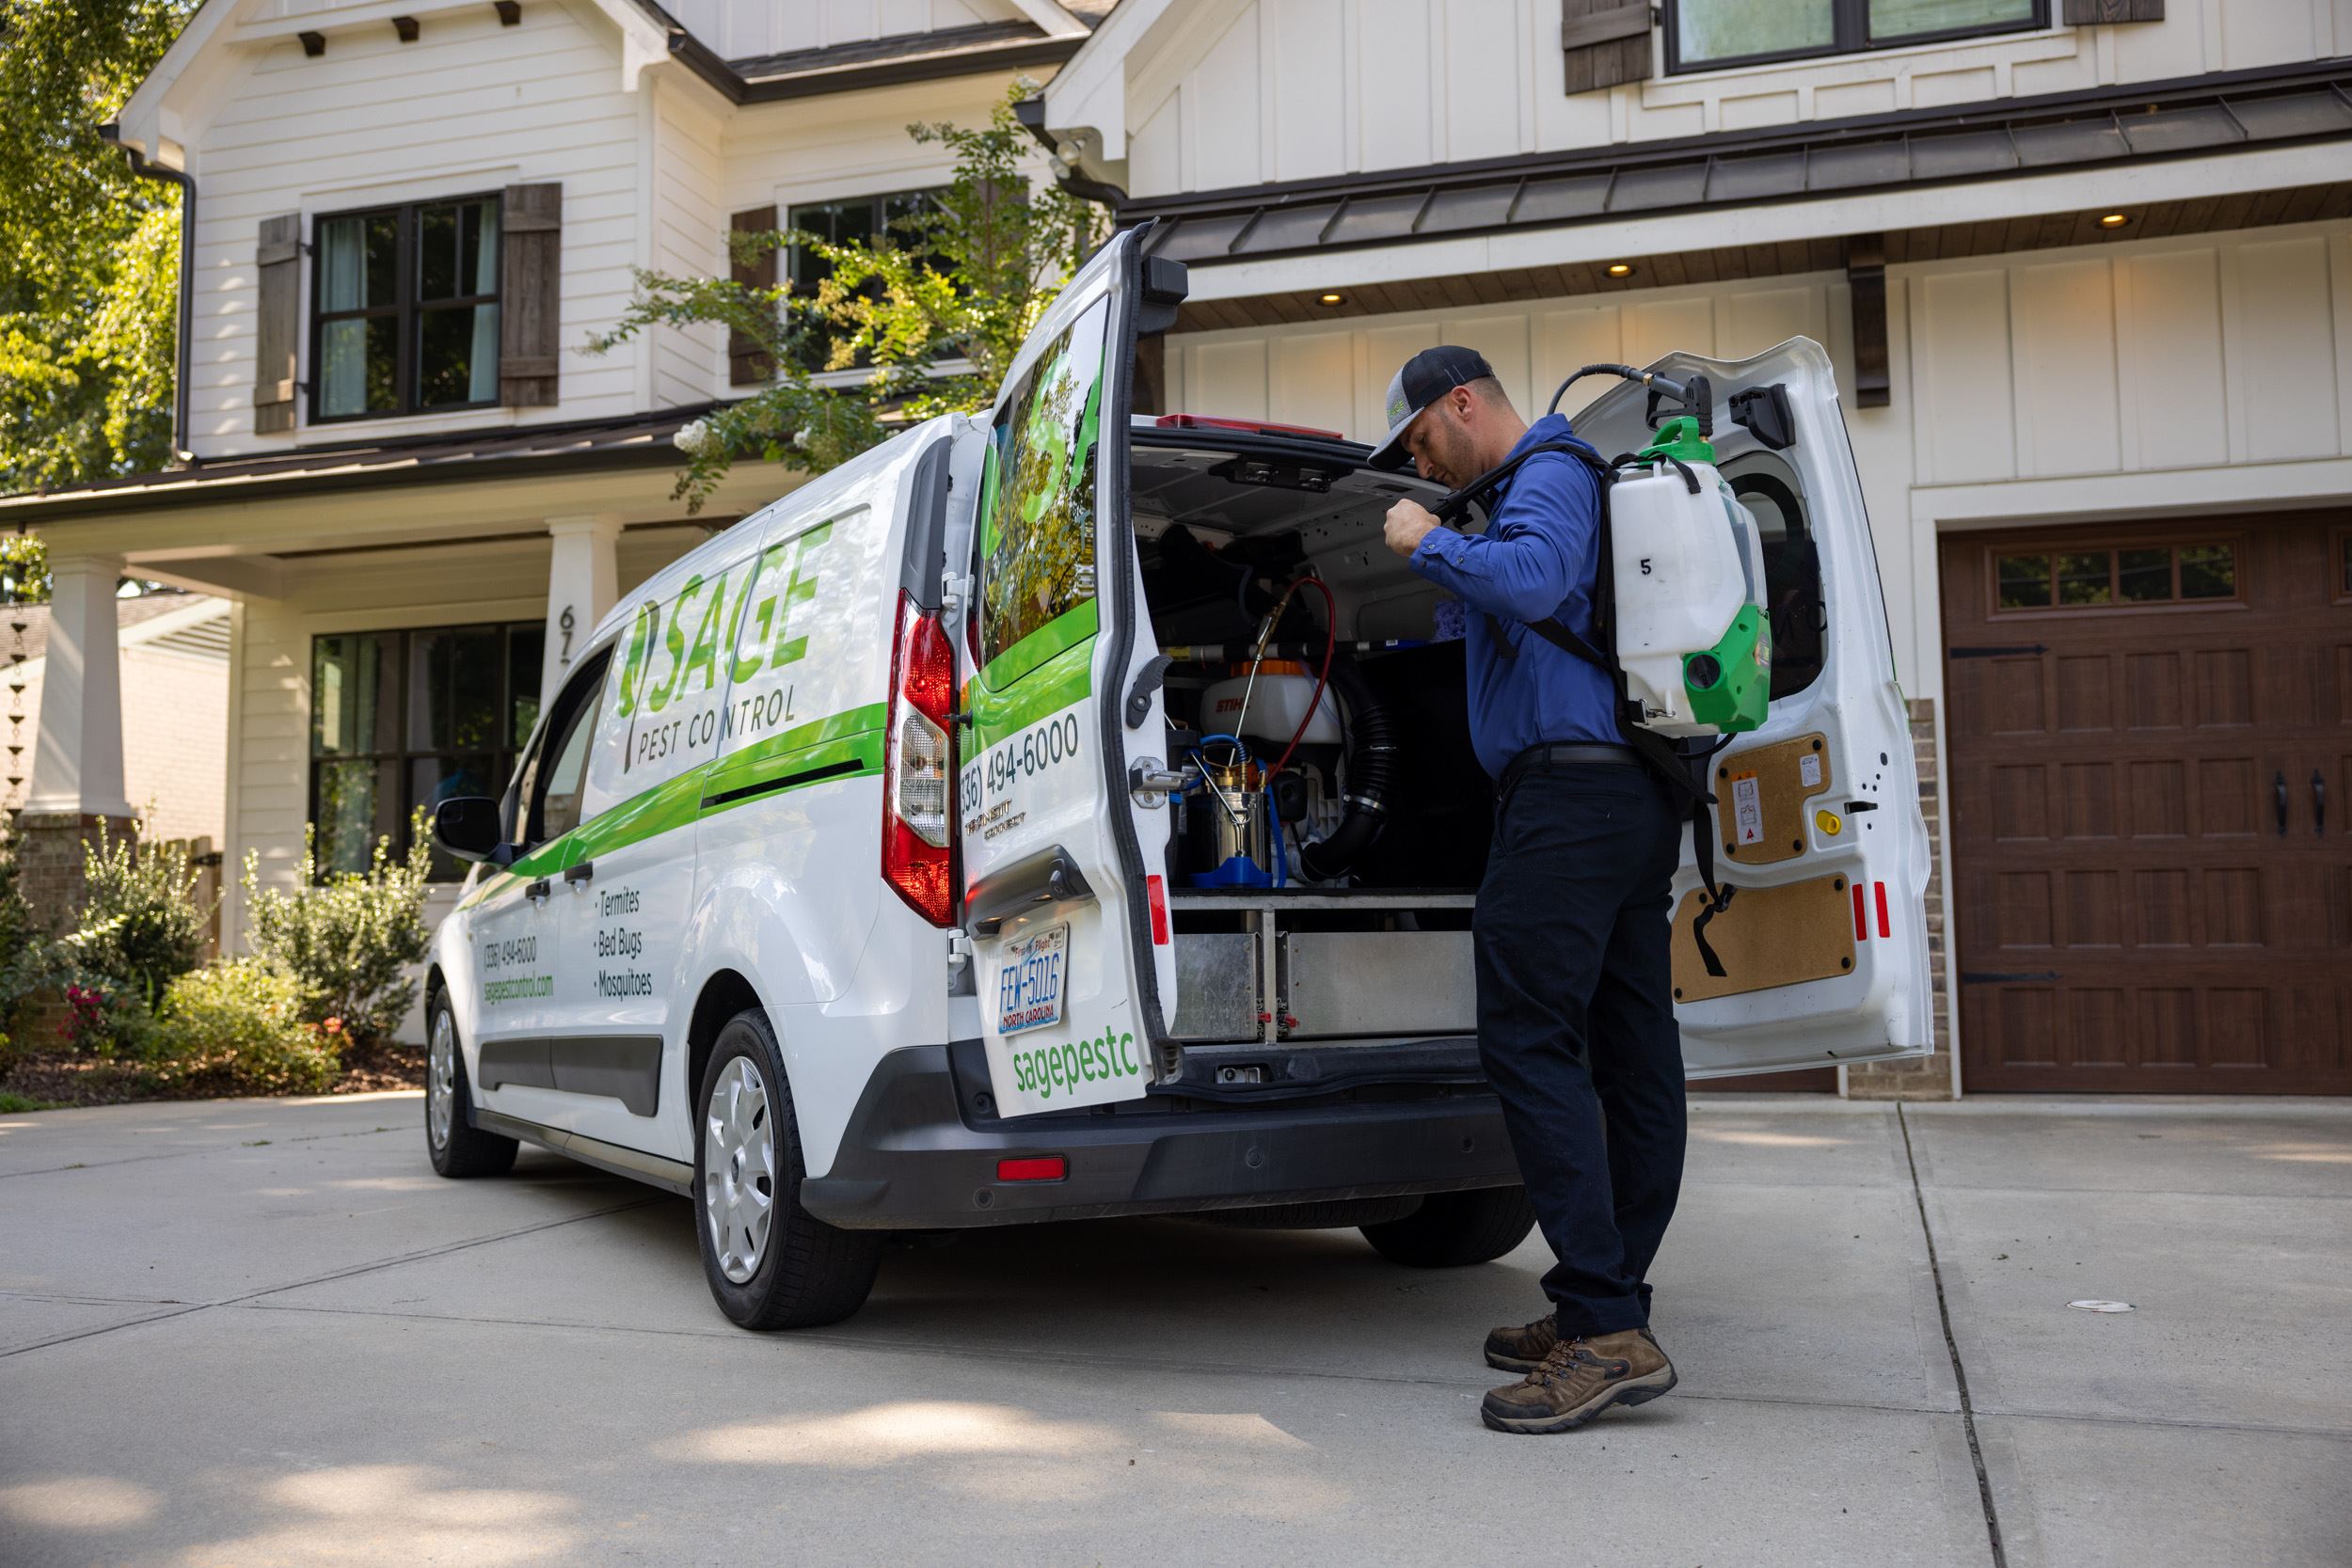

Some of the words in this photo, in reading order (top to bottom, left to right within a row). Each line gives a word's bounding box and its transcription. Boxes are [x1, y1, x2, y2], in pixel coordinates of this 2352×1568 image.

[1640, 558, 1652, 576] 5
[648, 519, 834, 714] SAGE
[560, 604, 575, 665] 67
[1216, 697, 1249, 712] STIH
[637, 720, 682, 765] PEST
[688, 684, 795, 750] CONTROL
[987, 712, 1078, 795] 494-6000
[600, 886, 640, 918] Termites
[501, 935, 536, 966] 494-6000
[598, 927, 616, 958] Bed
[618, 927, 643, 960] Bugs
[1035, 937, 1050, 952] Flight
[484, 970, 554, 1006] sagepestcontrol.com
[598, 967, 652, 1002] Mosquitoes
[1003, 1012, 1025, 1029] NORTH
[1025, 1004, 1054, 1024] CAROLINA
[1013, 1025, 1139, 1100] sagepestc
